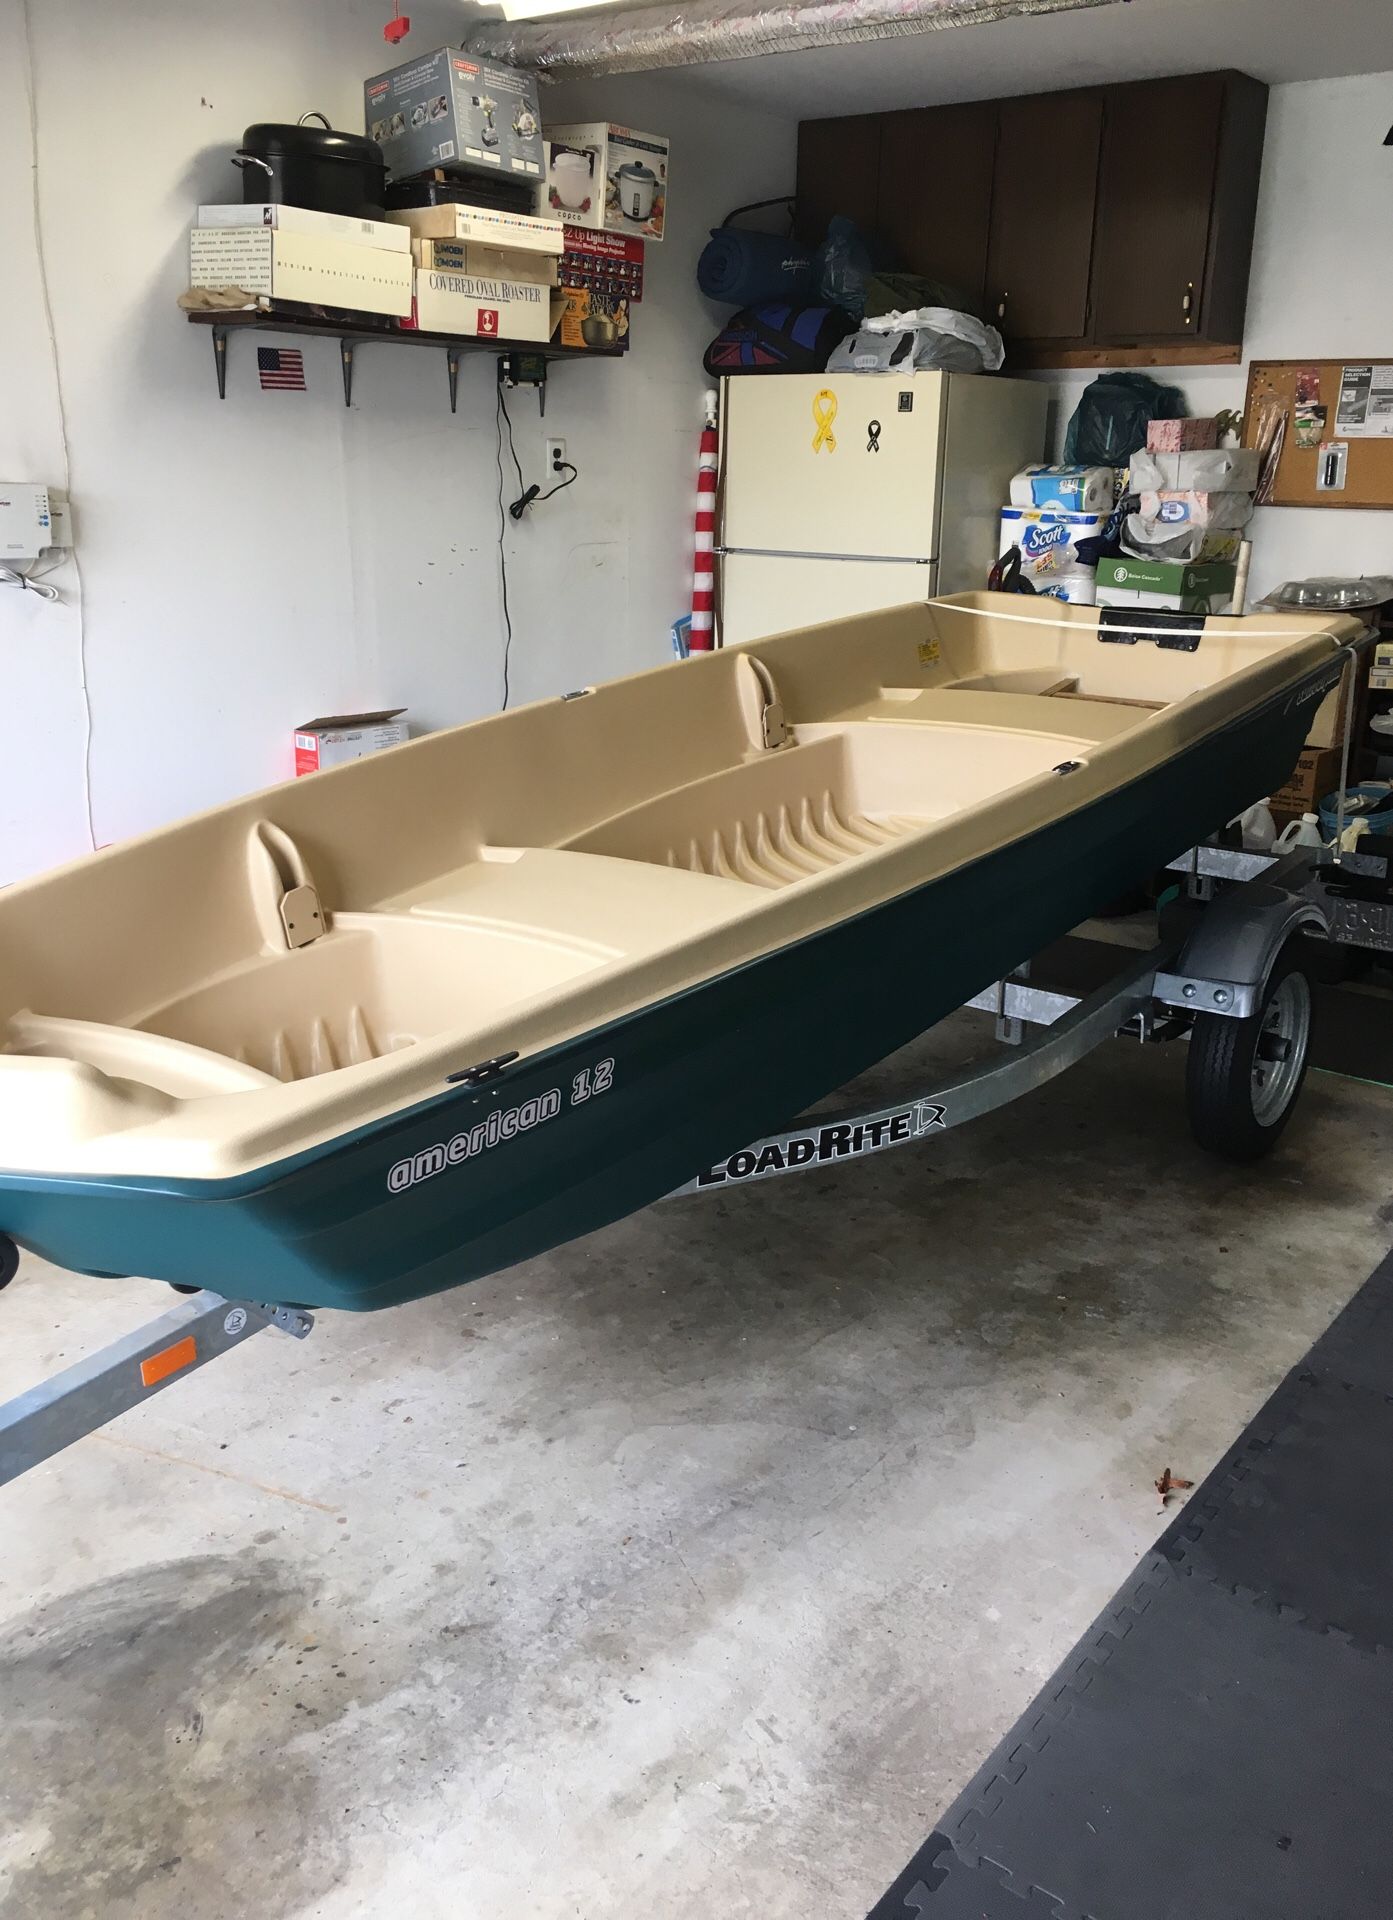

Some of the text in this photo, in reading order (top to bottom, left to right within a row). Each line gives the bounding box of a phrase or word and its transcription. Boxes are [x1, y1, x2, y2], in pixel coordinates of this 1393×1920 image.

[586, 231, 605, 245] Light
[605, 235, 626, 248] Show
[429, 272, 474, 296] COVERED
[476, 279, 501, 299] OVAL
[501, 282, 541, 303] ROASTER
[1029, 525, 1063, 548] Scott
[388, 1058, 615, 1193] american 12
